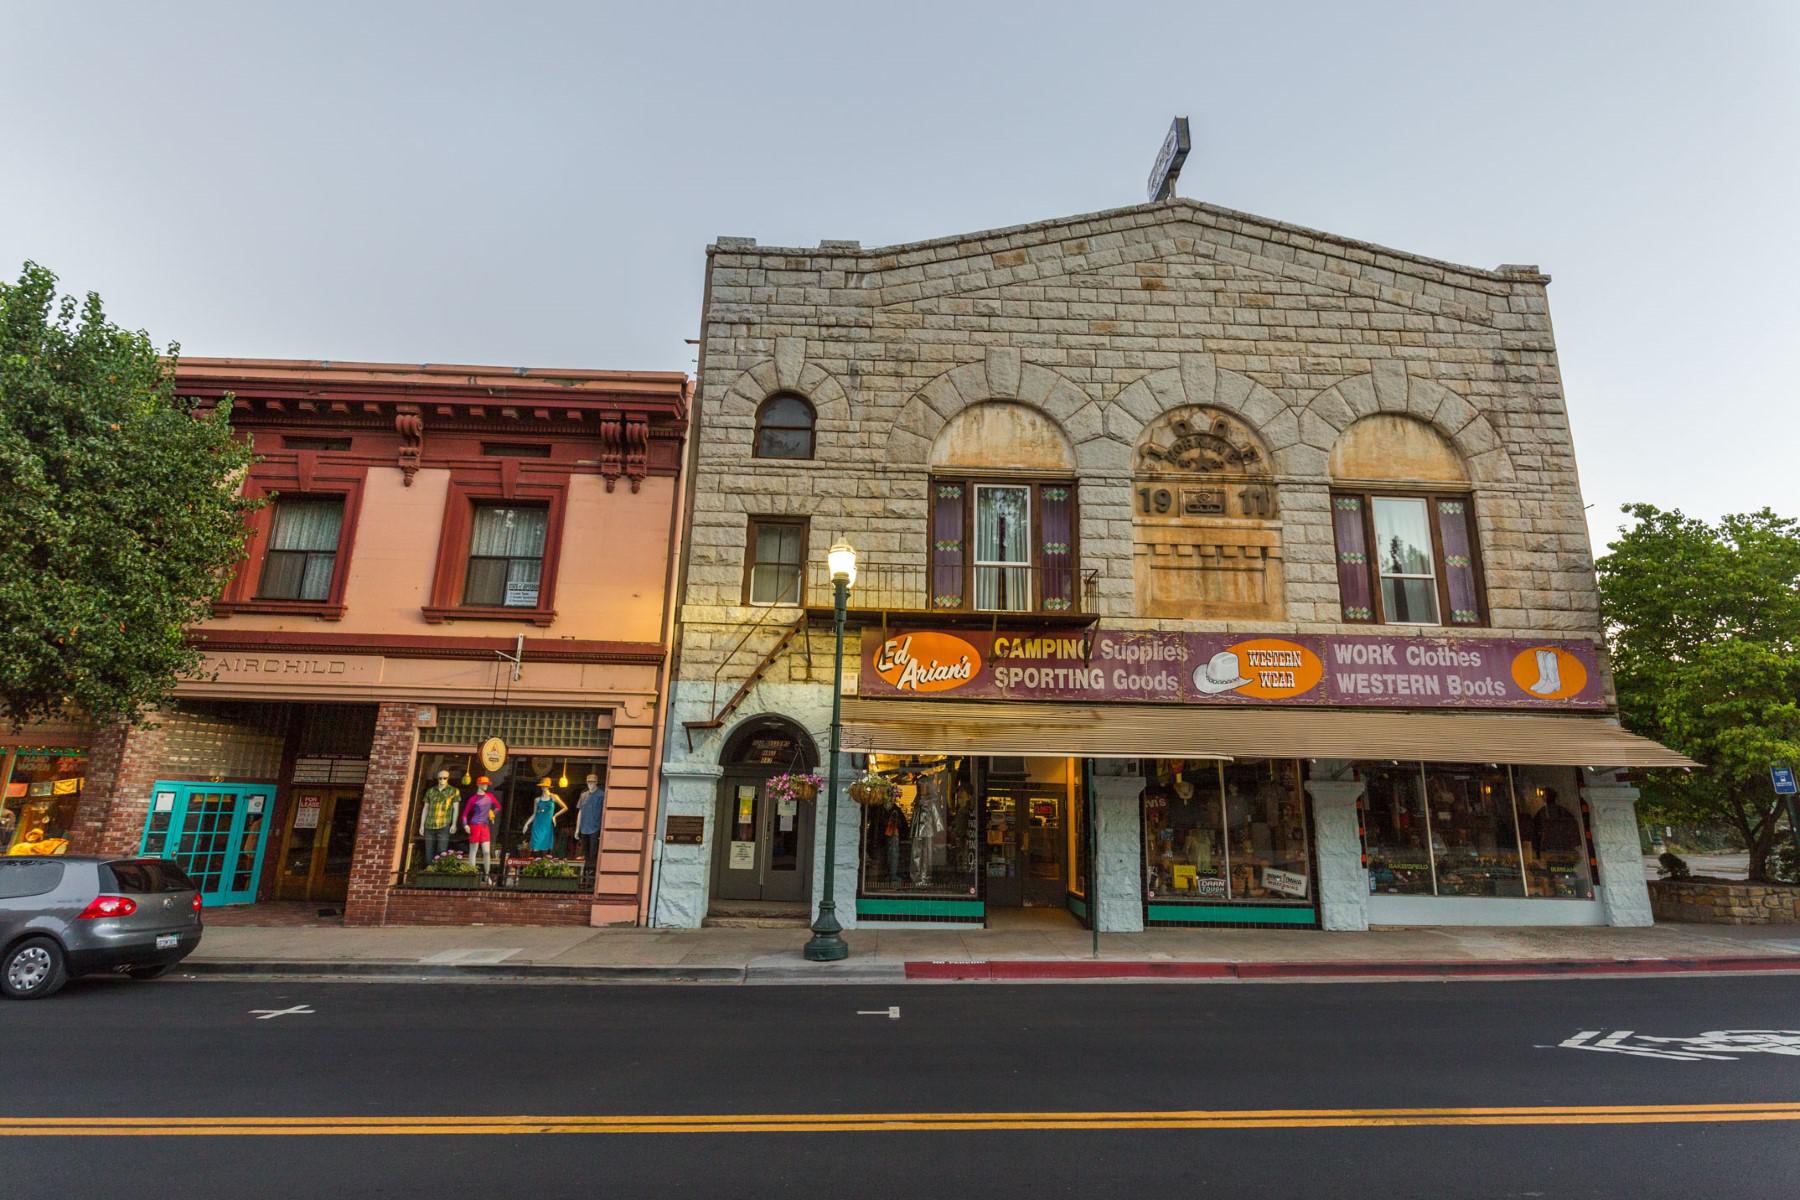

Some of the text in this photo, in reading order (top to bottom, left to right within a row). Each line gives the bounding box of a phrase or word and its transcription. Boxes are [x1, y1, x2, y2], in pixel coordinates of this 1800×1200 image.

[1138, 487, 1270, 515] 19 11
[878, 636, 912, 671] Ed
[994, 637, 1189, 664] CAMPING Supplies
[1247, 650, 1302, 667] WESTERN
[1334, 643, 1481, 667] WORK Clothes
[896, 656, 972, 690] Arian's
[994, 667, 1179, 691] SPORTING Goods
[1258, 671, 1296, 688] WEAR
[1336, 673, 1506, 696] WESTERN Boots
